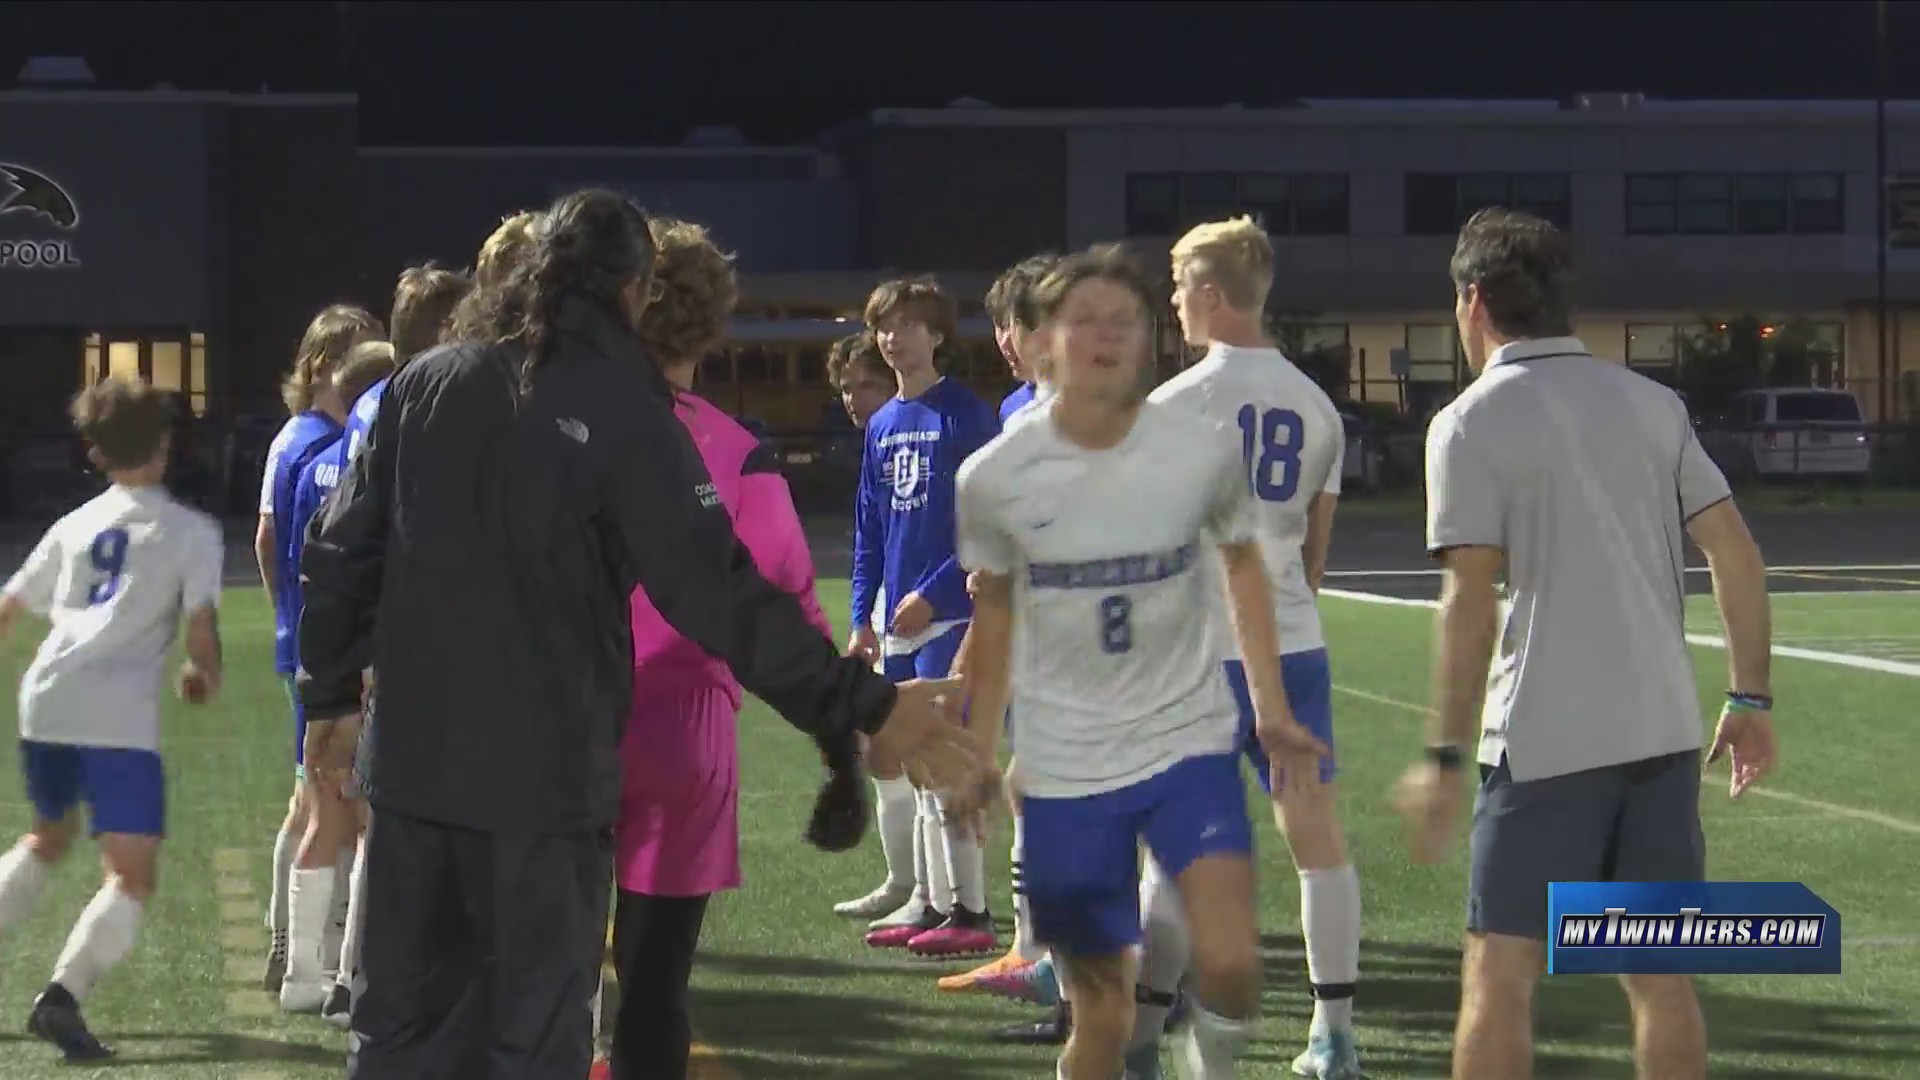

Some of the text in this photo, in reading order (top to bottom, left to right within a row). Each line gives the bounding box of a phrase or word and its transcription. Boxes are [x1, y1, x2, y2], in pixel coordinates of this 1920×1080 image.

[1238, 404, 1304, 502] 18
[88, 529, 128, 604] 9
[1102, 595, 1132, 653] 8
